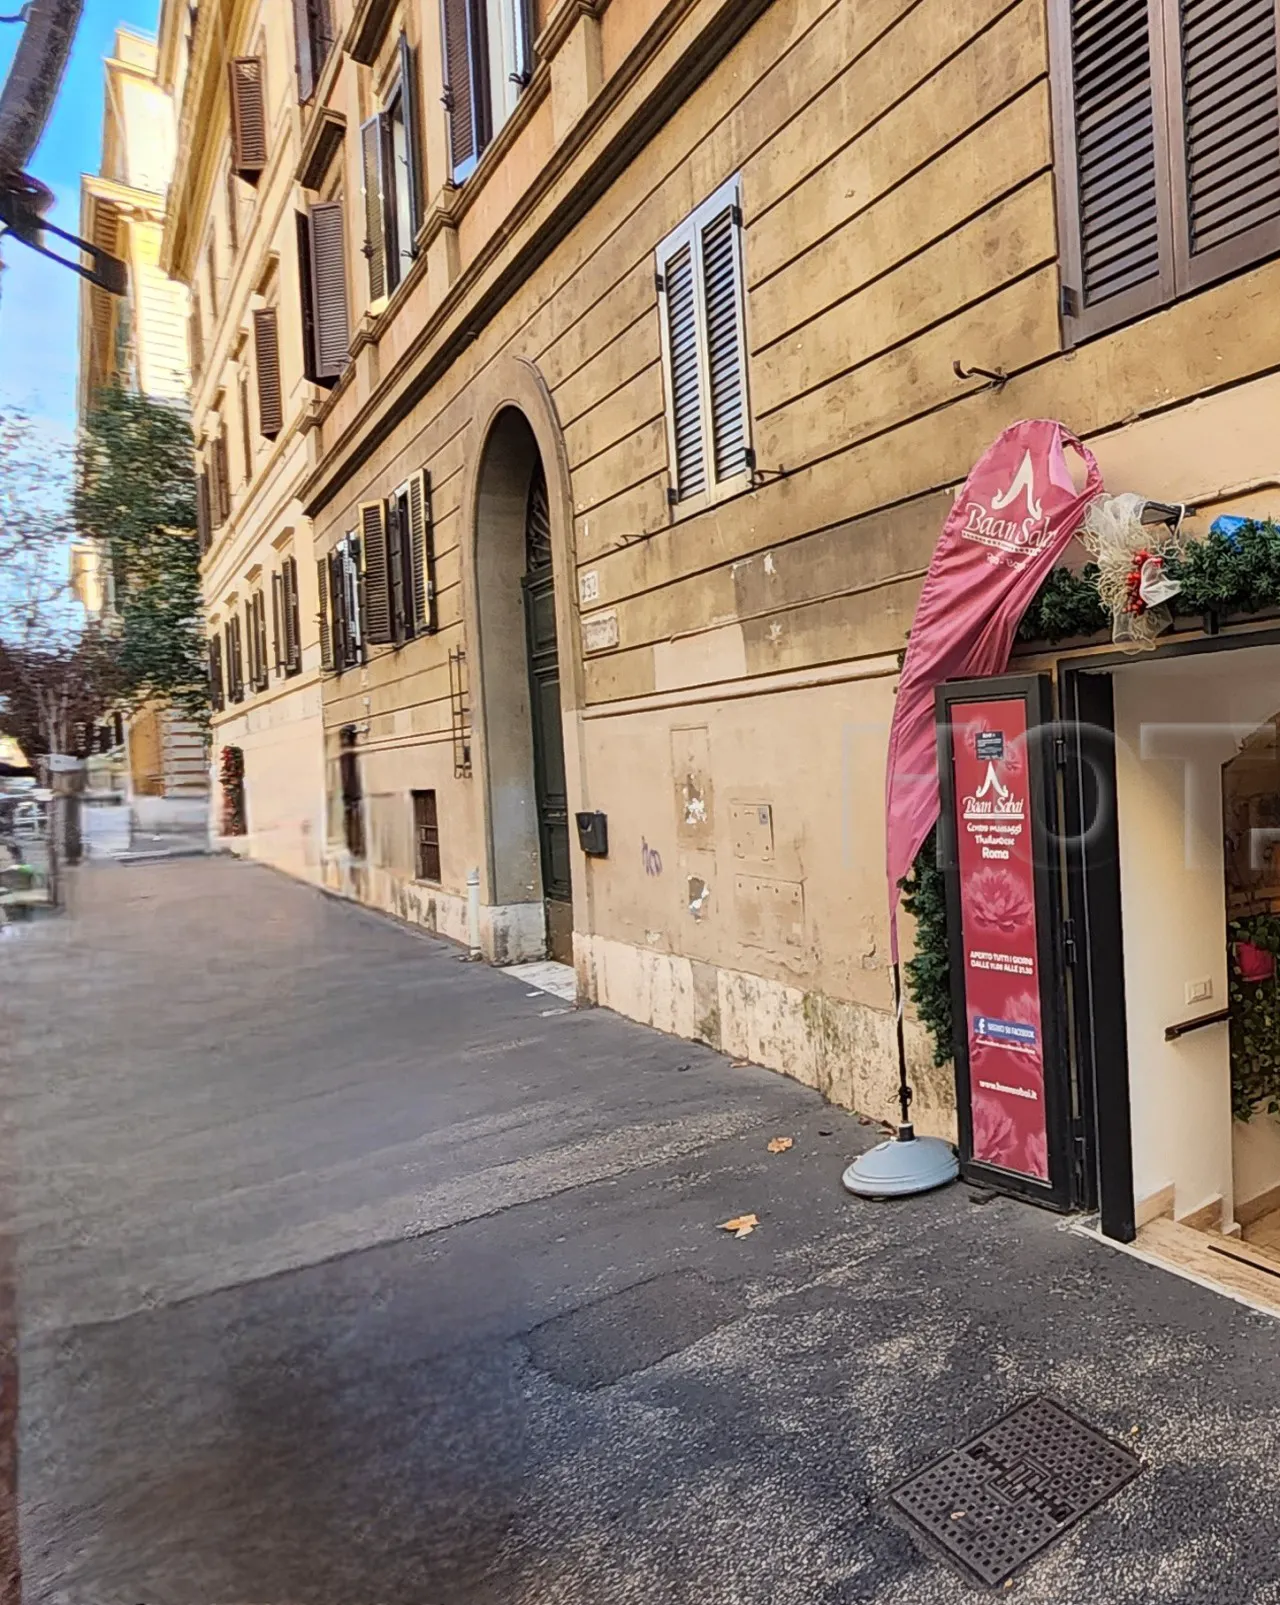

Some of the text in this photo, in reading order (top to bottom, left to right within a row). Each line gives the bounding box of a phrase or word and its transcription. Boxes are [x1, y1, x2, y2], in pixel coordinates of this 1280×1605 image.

[964, 502, 1017, 541] Baan
[963, 792, 1024, 813] Baan Sabai
[982, 846, 1009, 860] Roma
[970, 950, 993, 961] APERTO
